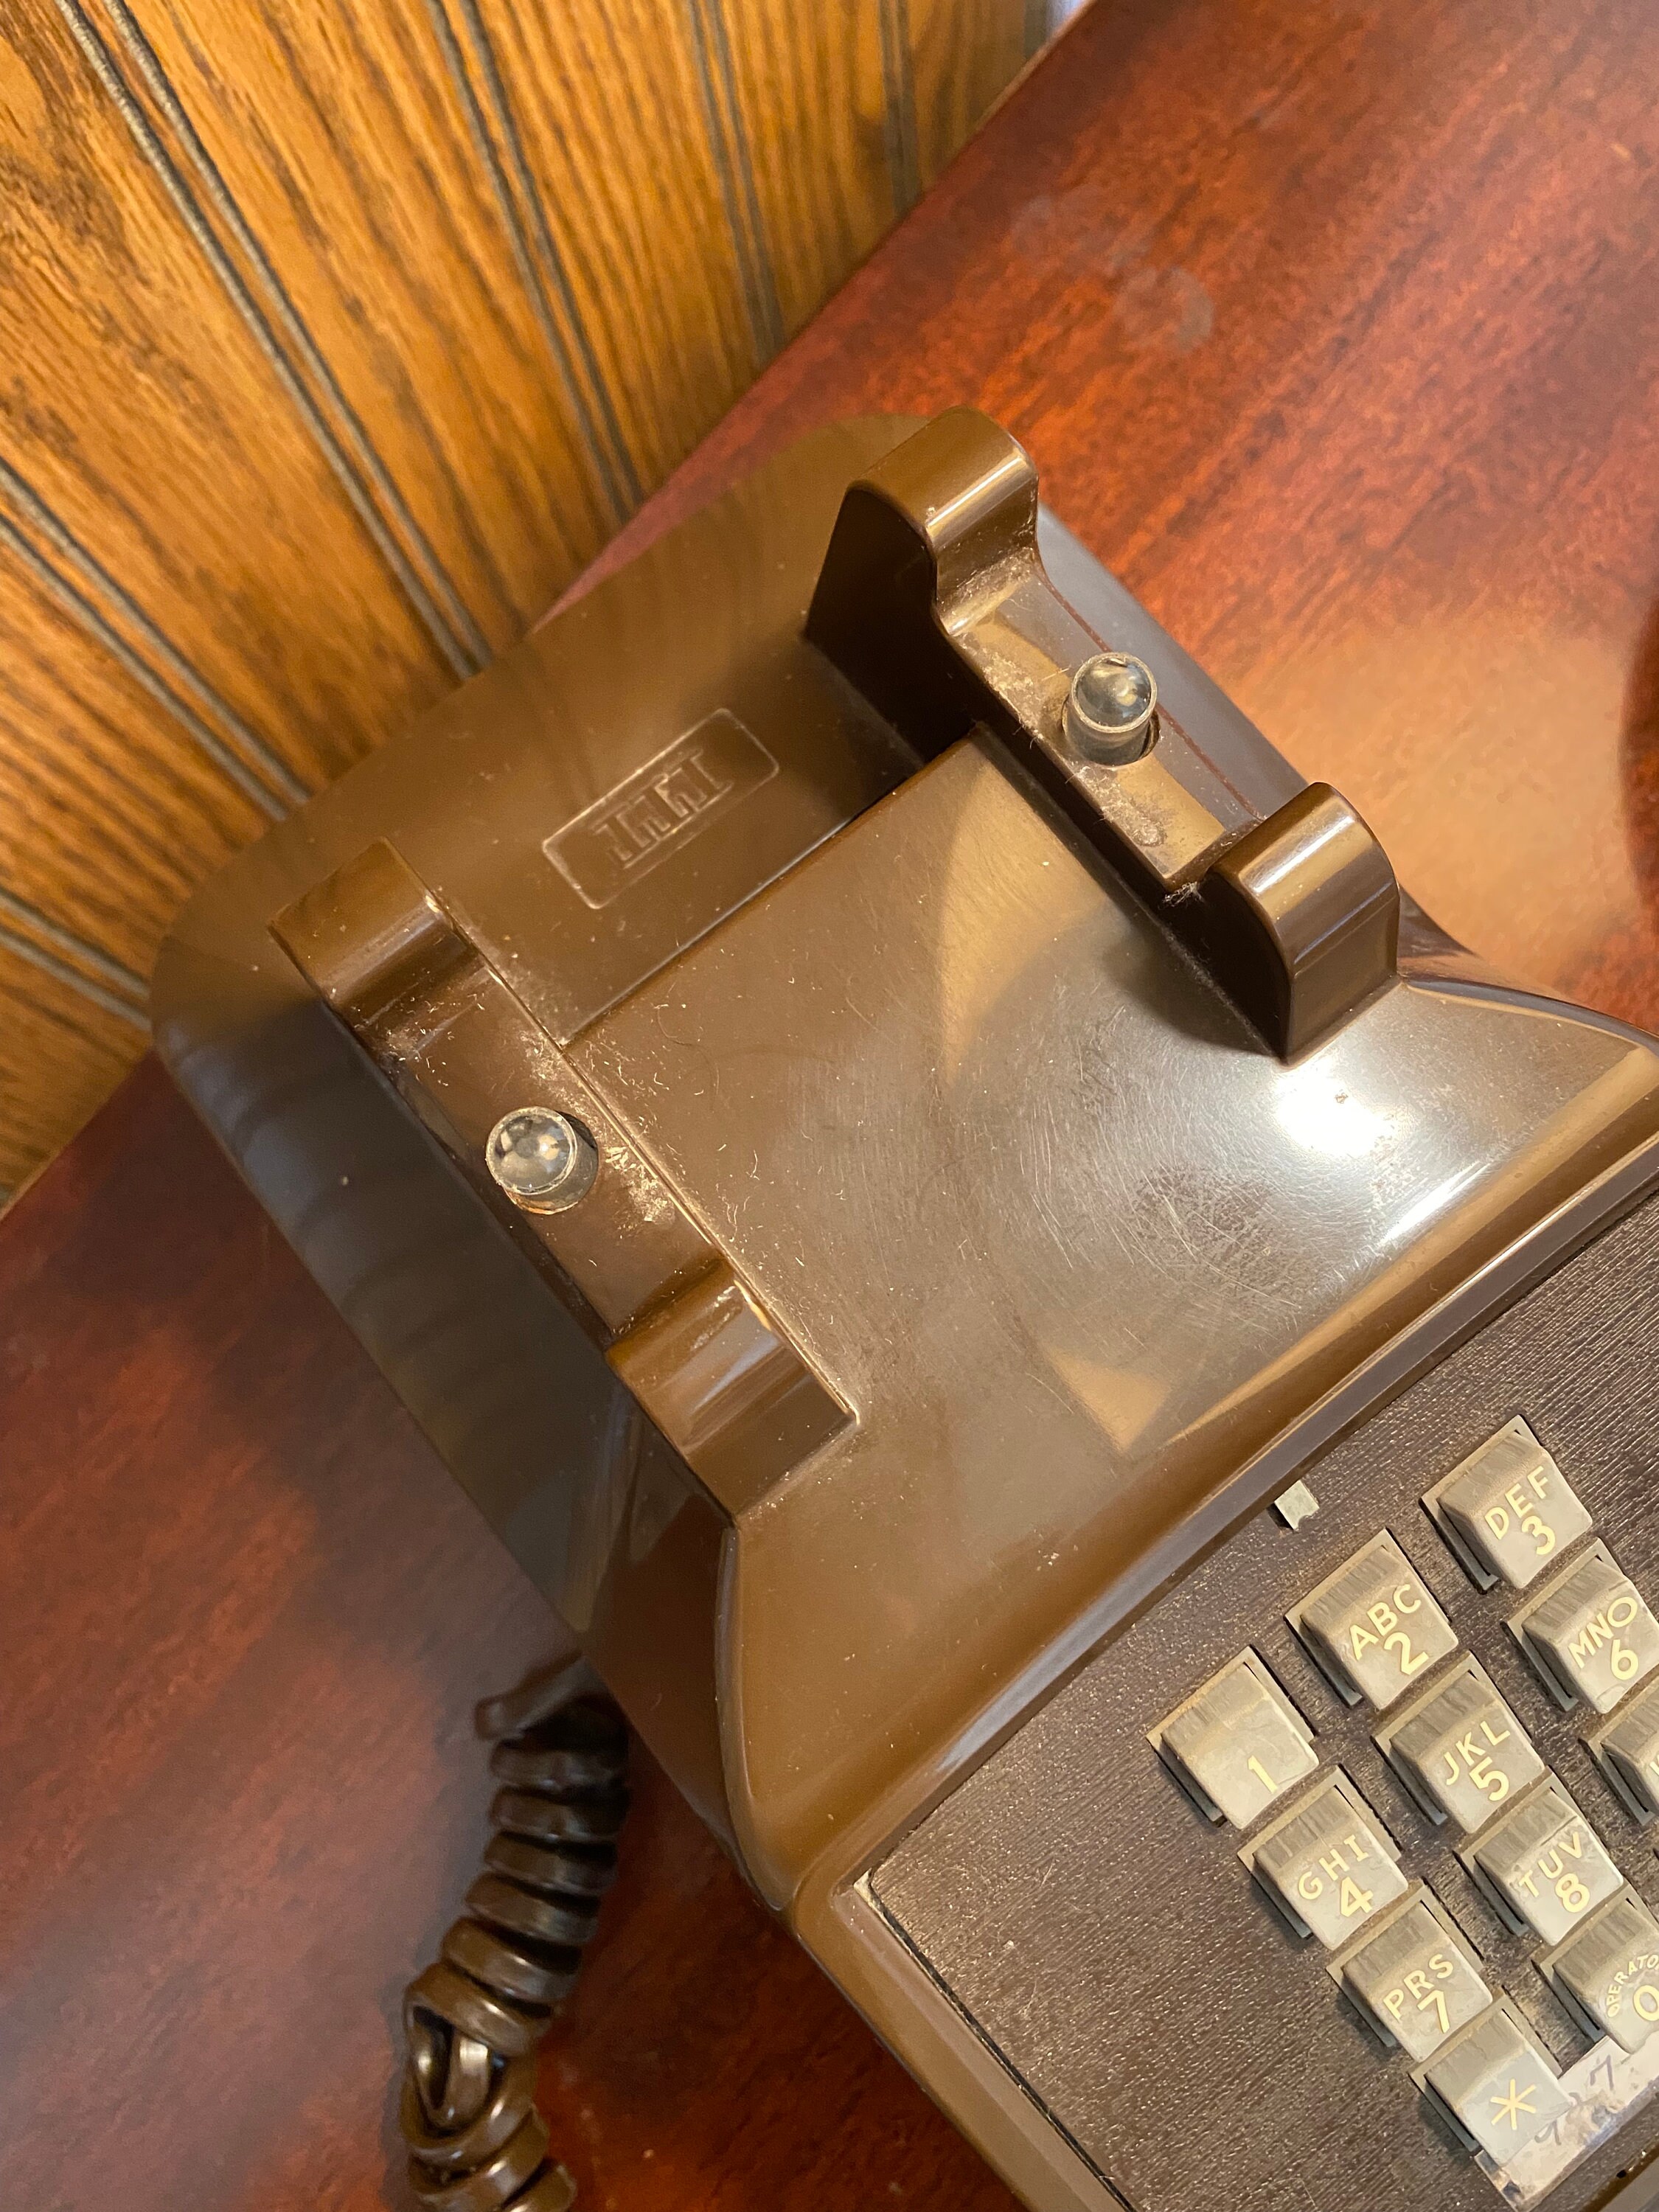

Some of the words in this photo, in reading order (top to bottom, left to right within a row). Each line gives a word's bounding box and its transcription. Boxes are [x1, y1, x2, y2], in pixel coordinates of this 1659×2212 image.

[1484, 1466, 1548, 1540] DEF
[1522, 1516, 1556, 1555] 3
[1349, 1584, 1422, 1660] ABC
[1568, 1596, 1638, 1669] MNO
[1384, 1632, 1429, 1675] 2
[1610, 1639, 1638, 1680] 6
[1247, 1756, 1279, 1793] 1
[1444, 1721, 1510, 1785] JKL
[1469, 1756, 1509, 1801] 5
[1298, 1834, 1369, 1900] GHI
[1519, 1832, 1584, 1898] TUV
[1340, 1877, 1374, 1917] 4
[1554, 1873, 1590, 1913] 8
[1382, 1954, 1453, 2020] PRS
[1417, 1990, 1450, 2034] 7
[1607, 1954, 1659, 2017] OPERATO
